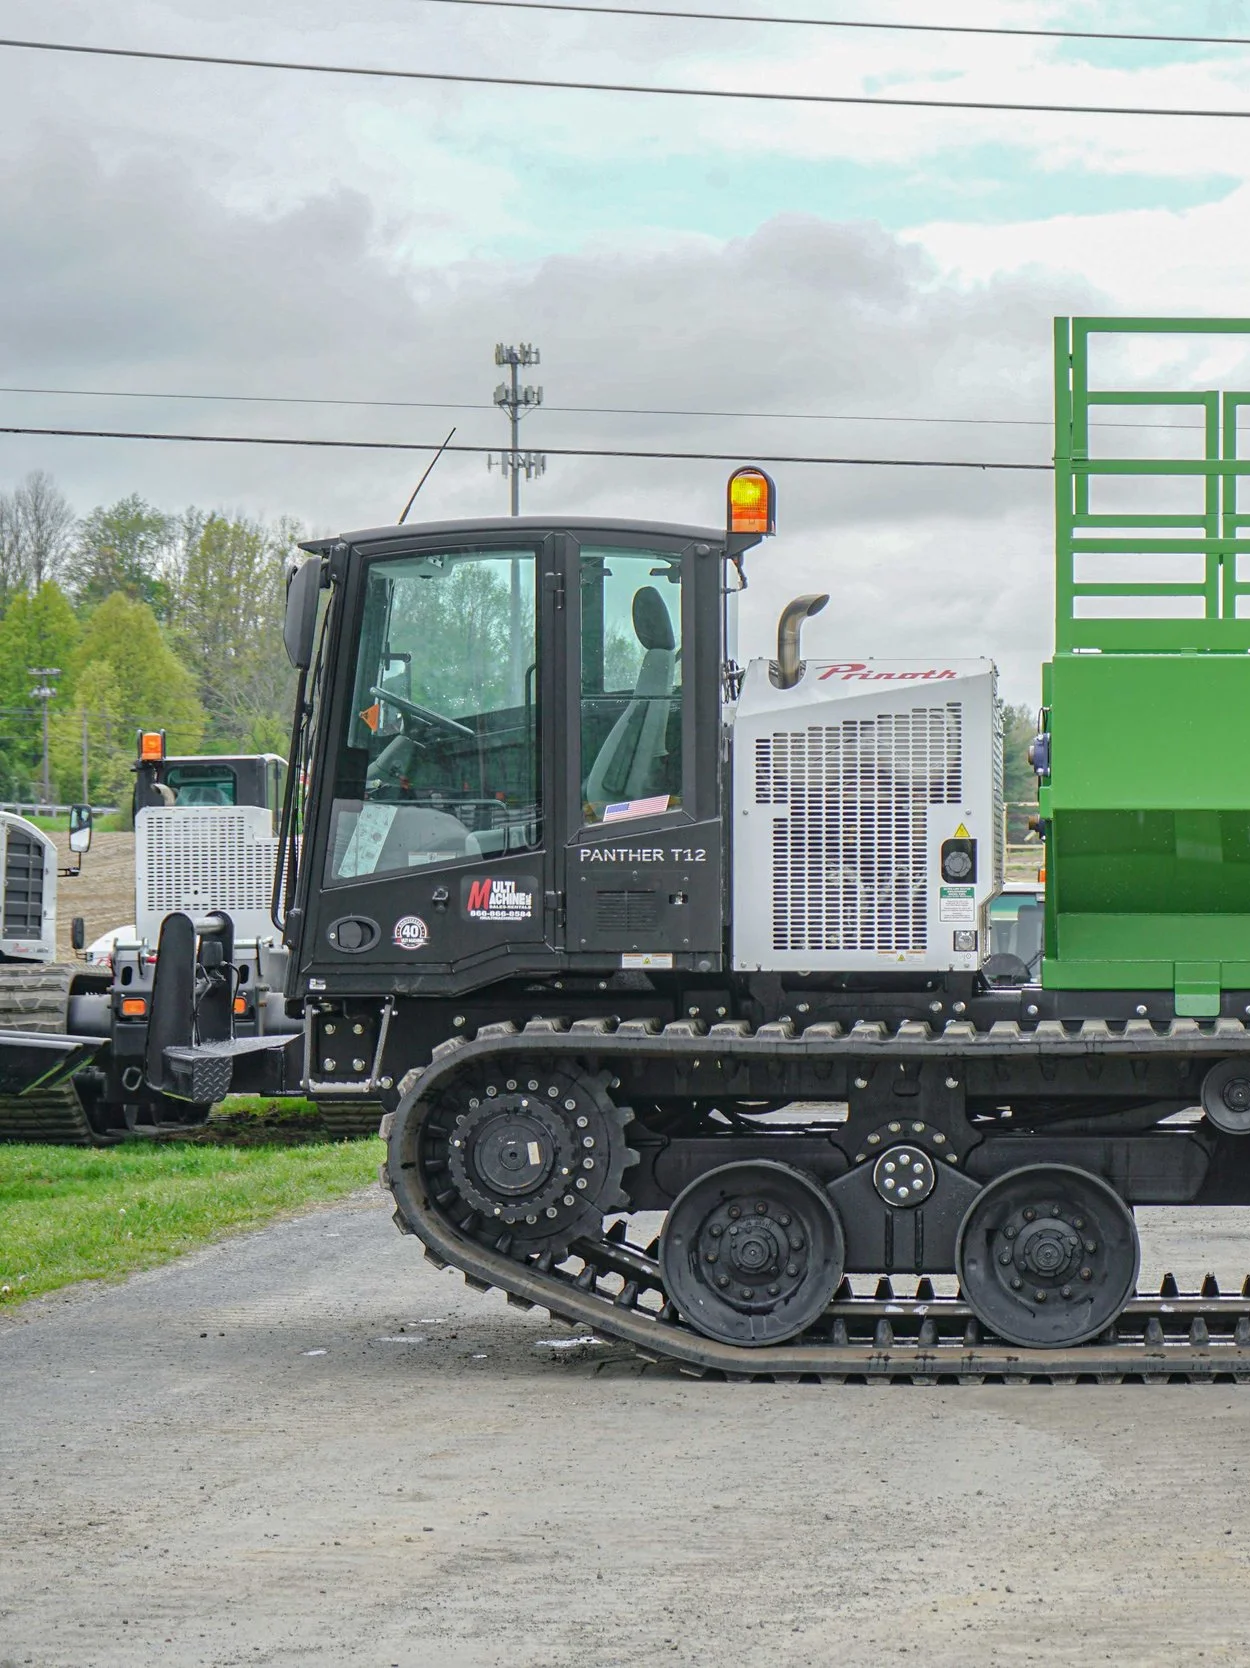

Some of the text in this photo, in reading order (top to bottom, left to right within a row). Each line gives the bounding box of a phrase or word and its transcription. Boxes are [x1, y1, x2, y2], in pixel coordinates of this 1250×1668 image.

[815, 663, 957, 680] Prinoth
[580, 849, 706, 862] PANTHER T12
[402, 925, 419, 938] 40
